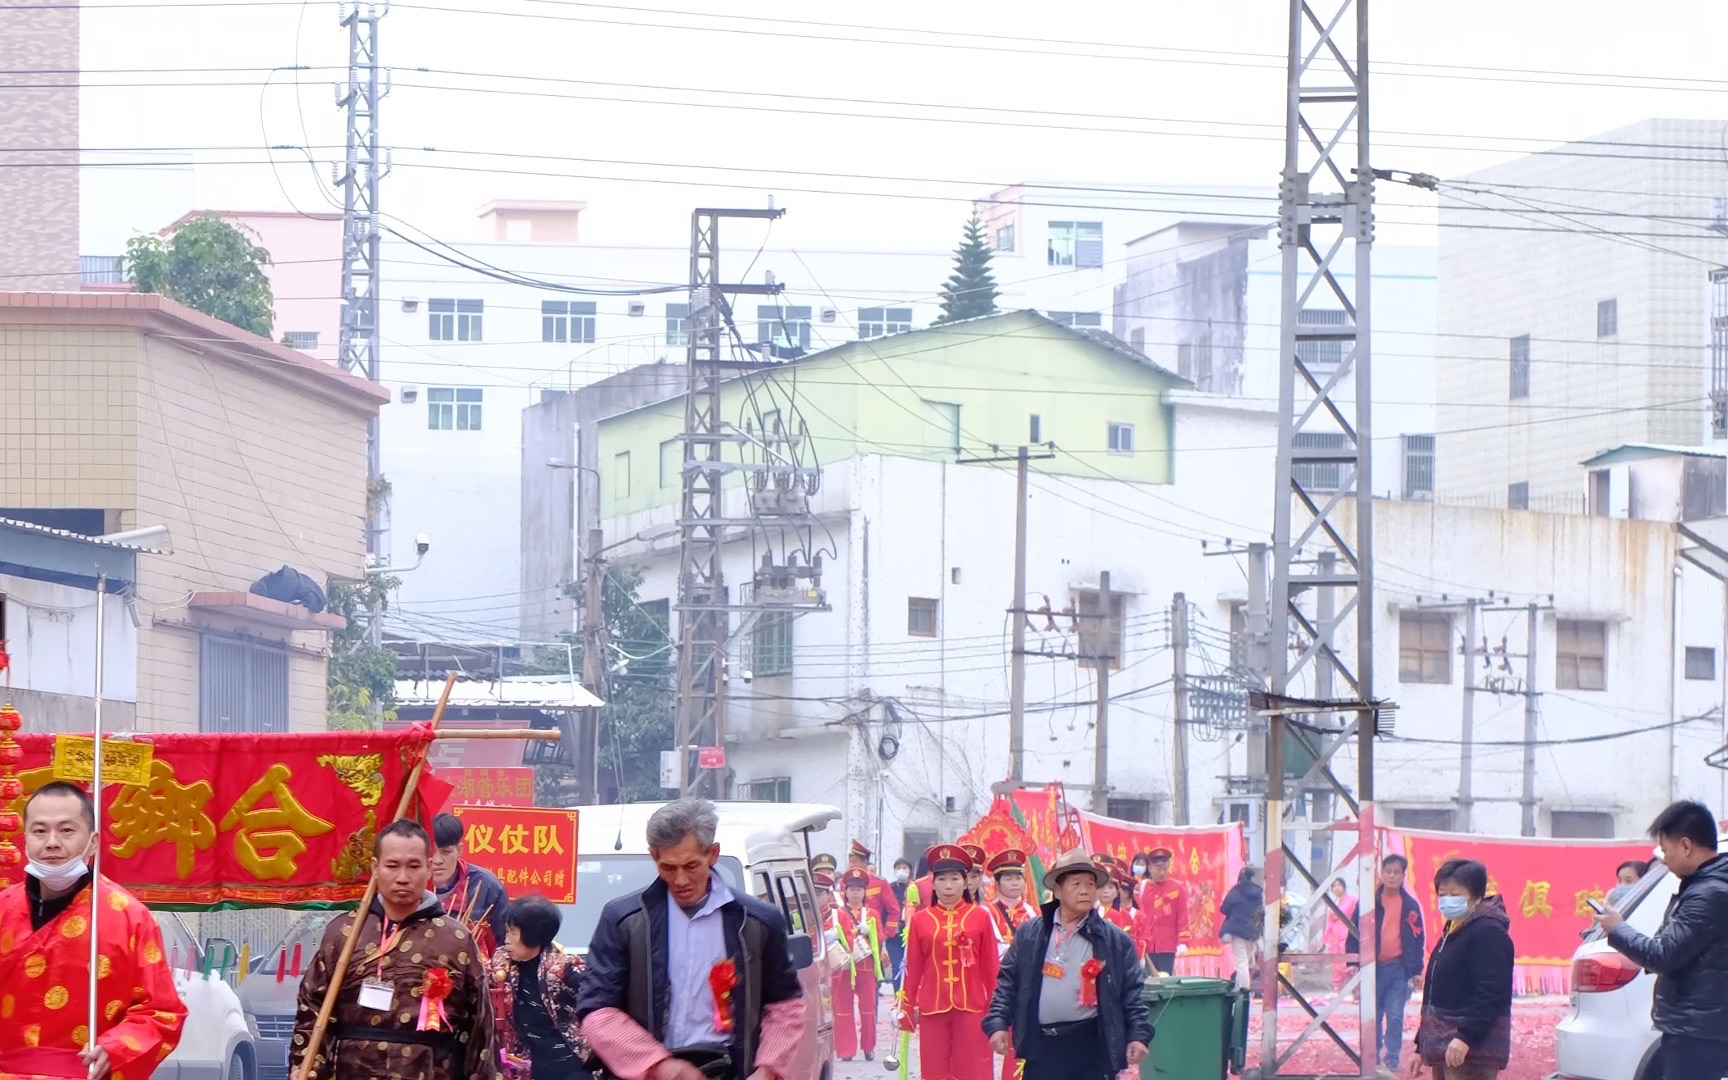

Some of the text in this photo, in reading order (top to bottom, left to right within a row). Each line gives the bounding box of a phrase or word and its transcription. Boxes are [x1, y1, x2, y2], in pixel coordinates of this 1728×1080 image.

[464, 823, 565, 856] 仪仗队
[485, 865, 566, 889] 具配件公司赠
